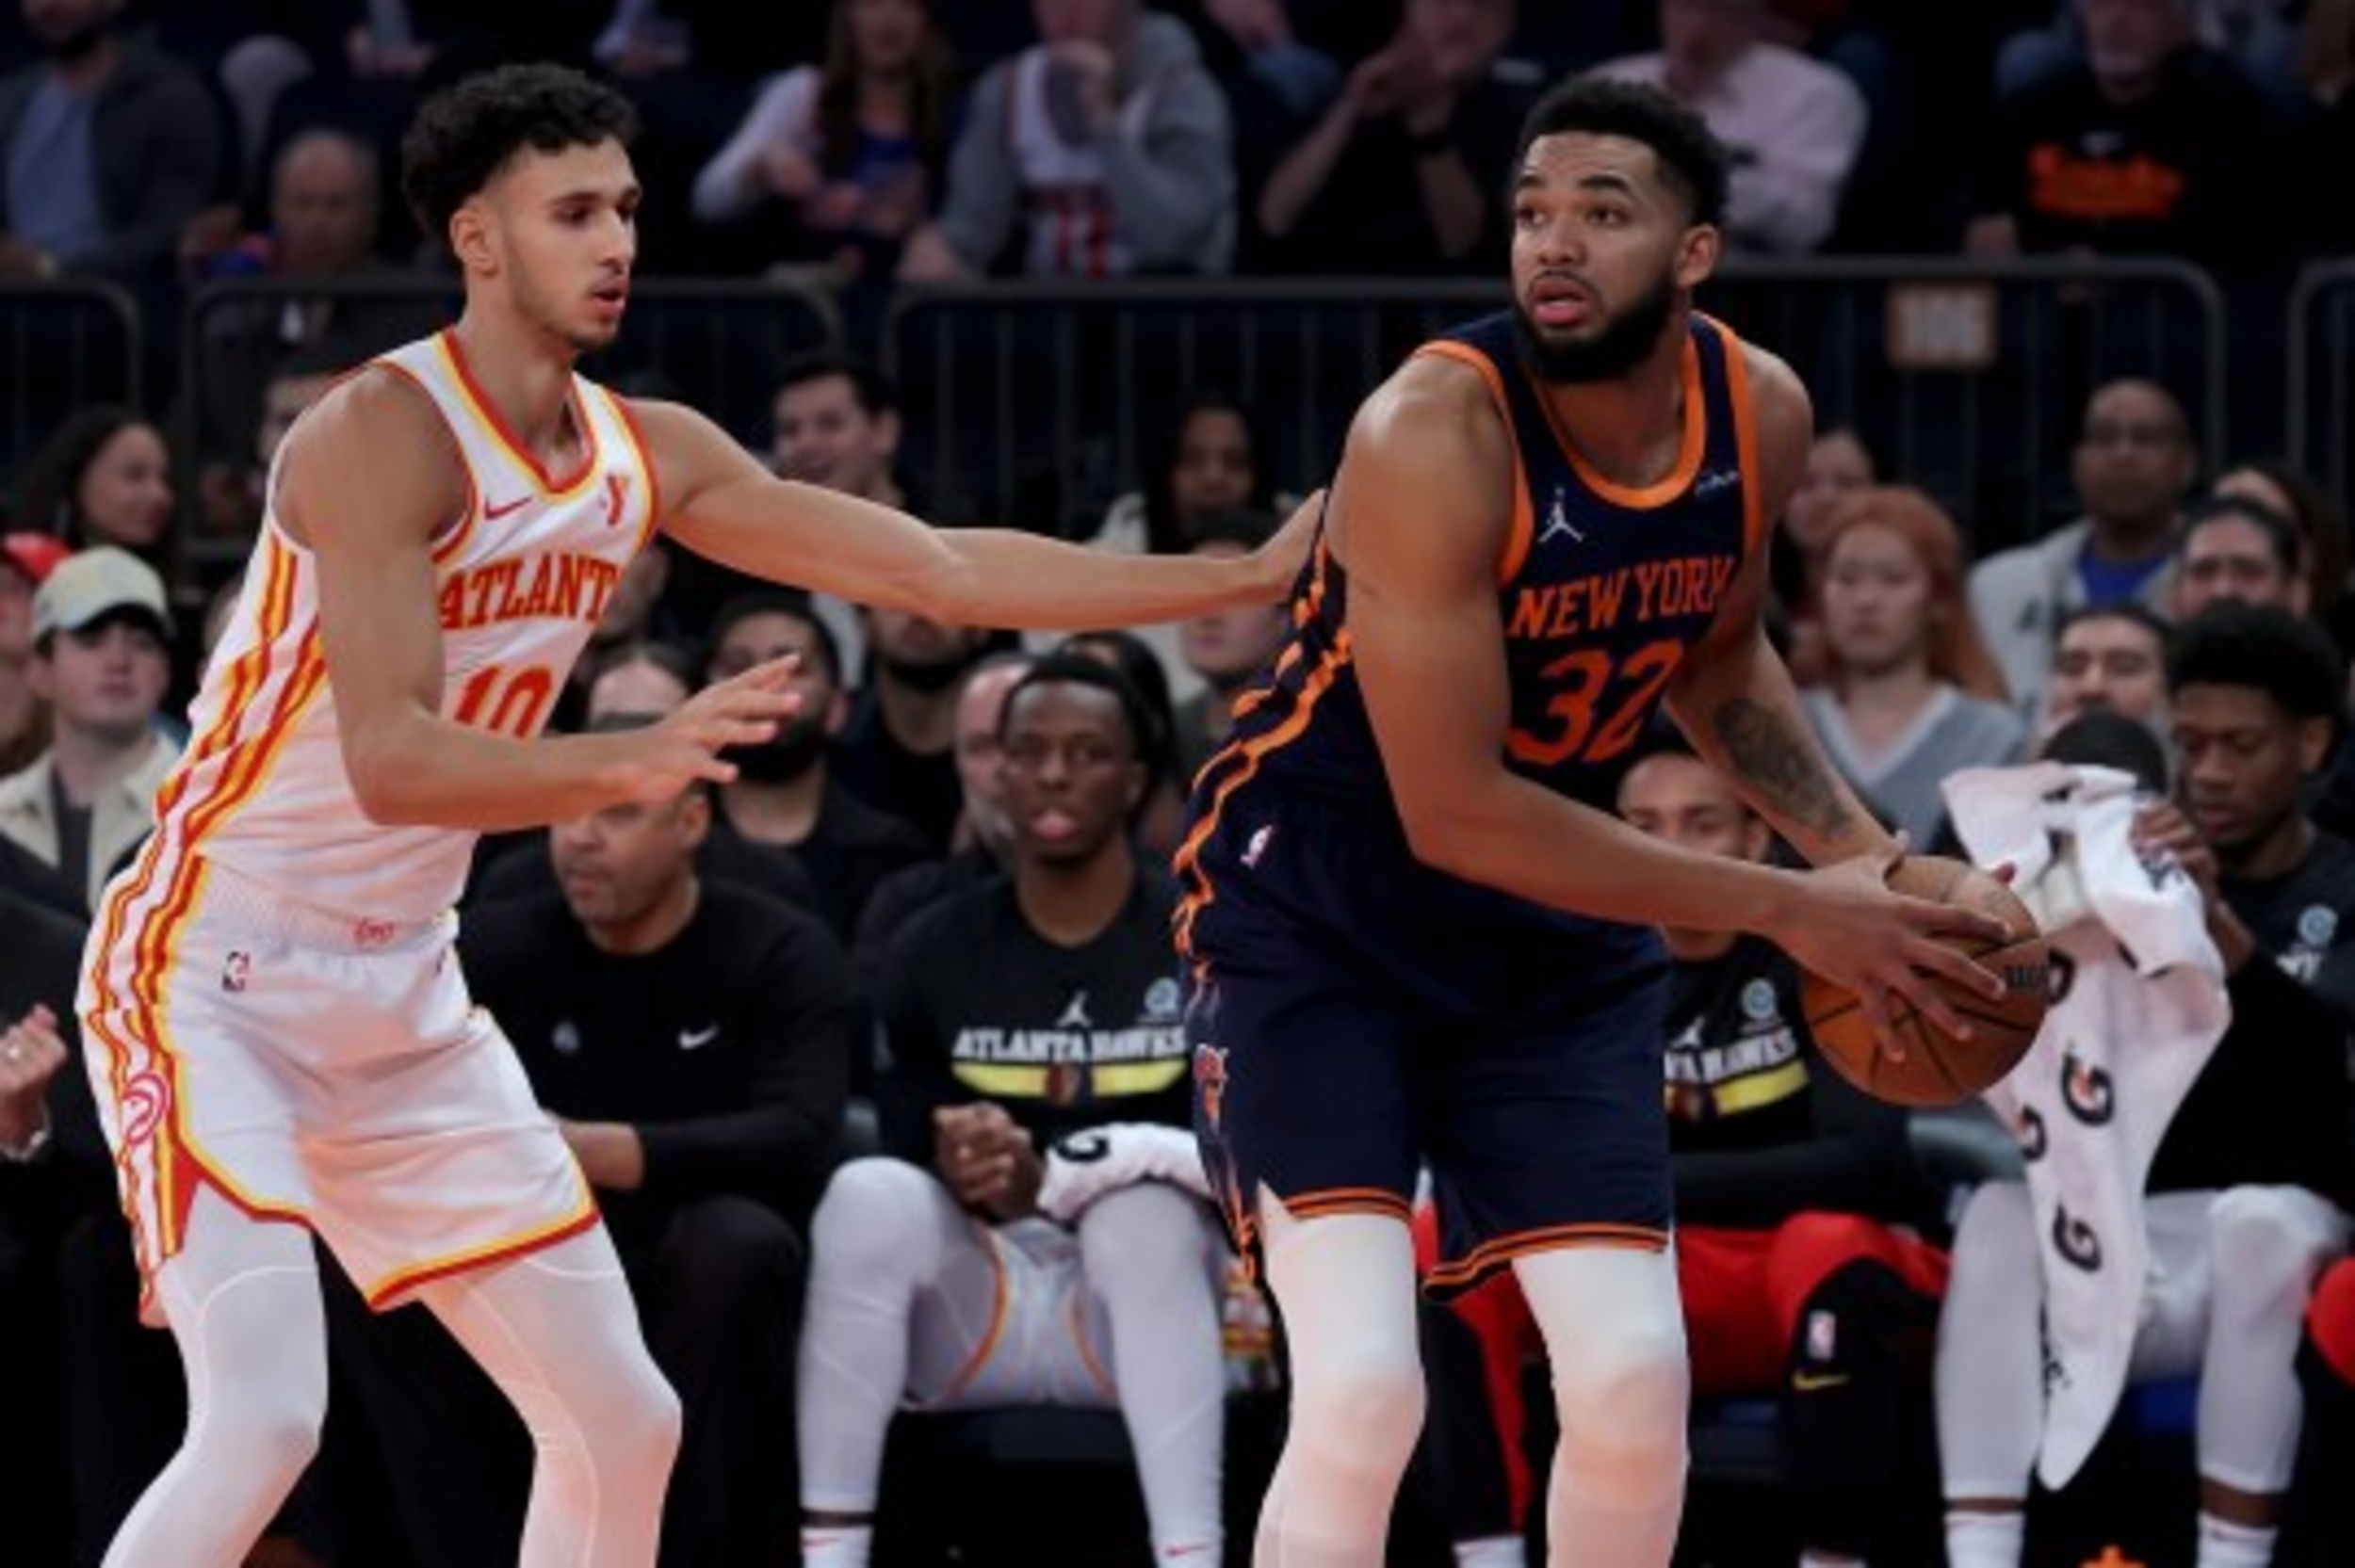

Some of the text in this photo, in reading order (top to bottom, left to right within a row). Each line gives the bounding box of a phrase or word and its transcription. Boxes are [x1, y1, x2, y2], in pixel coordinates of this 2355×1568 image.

[440, 551, 620, 629] ATLANT
[1507, 555, 1734, 639] NEW YORK
[454, 663, 553, 740] 10
[1509, 639, 1682, 765] 32
[951, 1026, 1186, 1062] ATLANTA HAWKS
[1699, 1024, 1797, 1084] HAWKS
[2061, 1049, 2115, 1127] G
[2053, 1203, 2103, 1273] G
